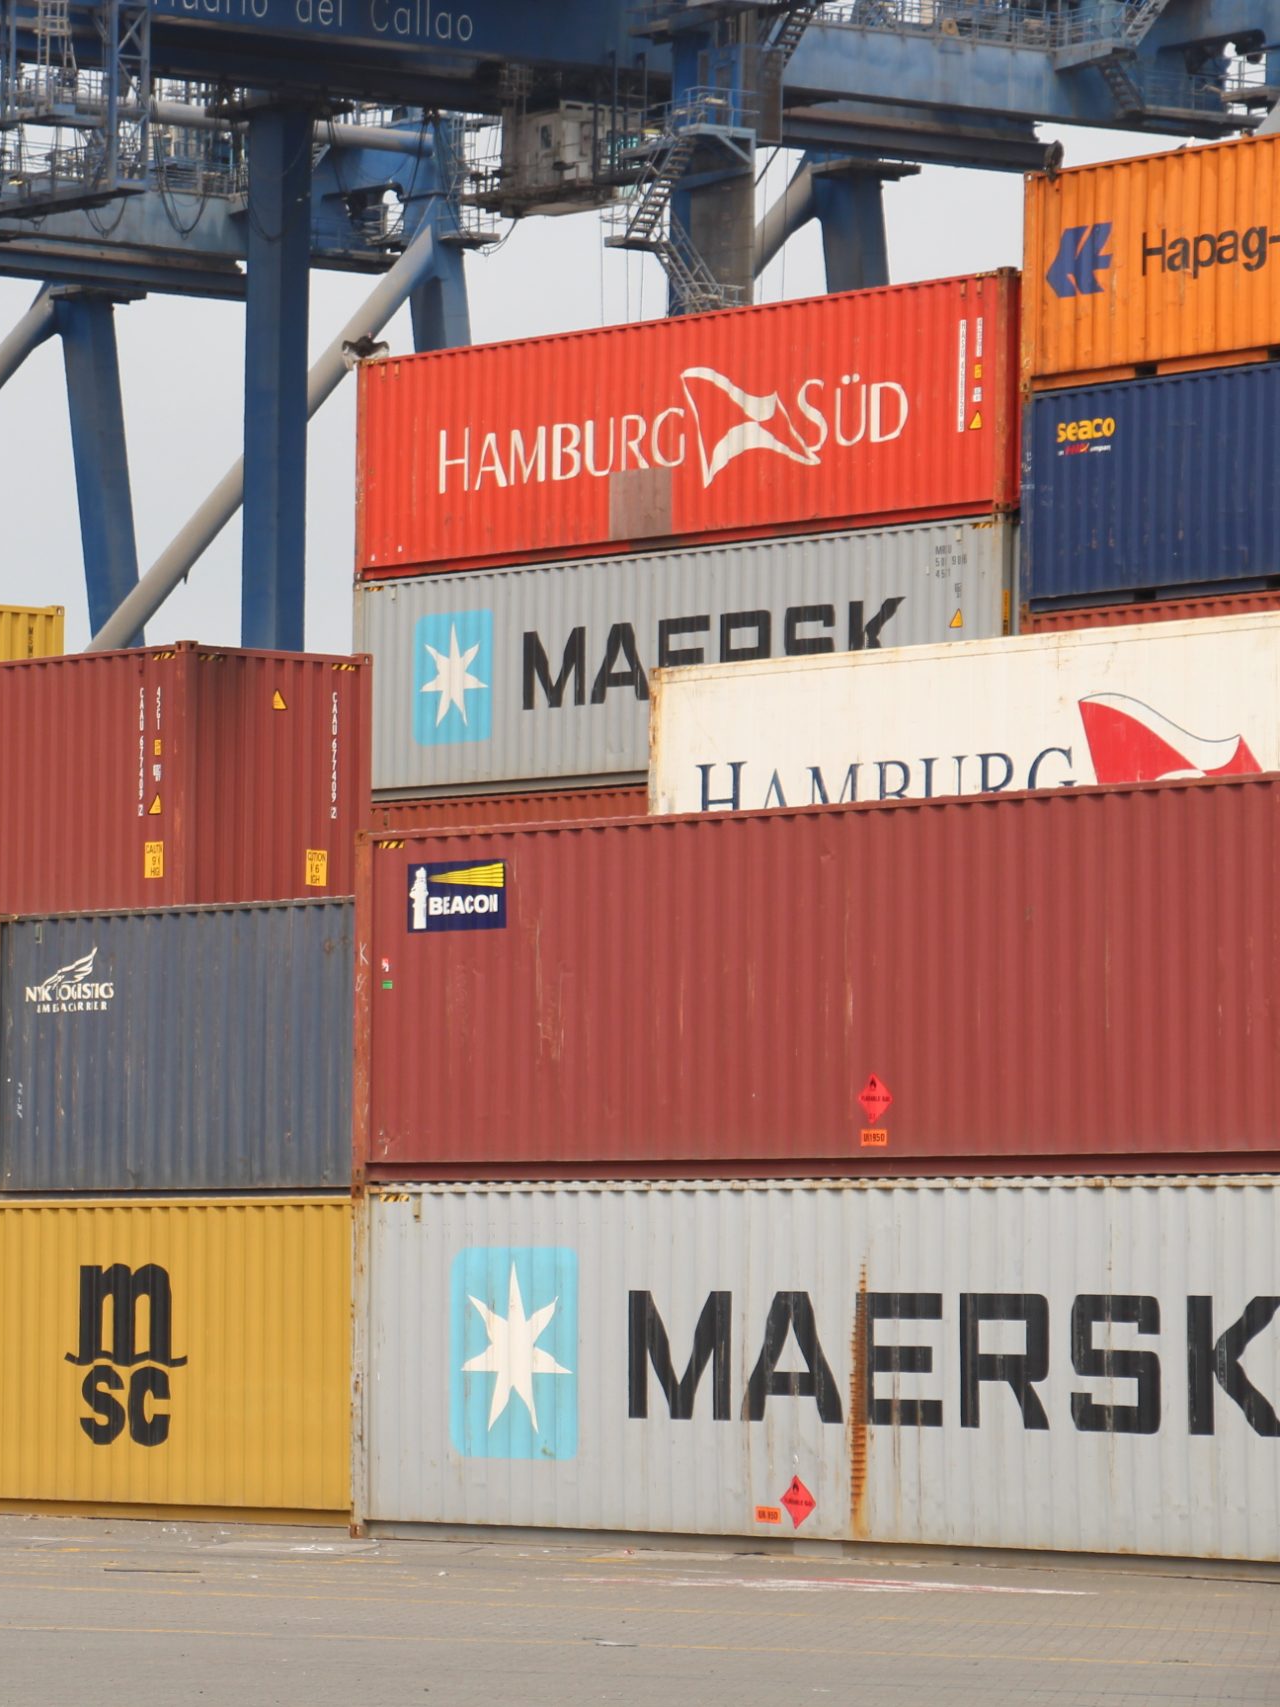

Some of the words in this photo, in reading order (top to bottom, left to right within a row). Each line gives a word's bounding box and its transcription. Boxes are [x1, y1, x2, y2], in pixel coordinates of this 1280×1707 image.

[371, 0, 473, 42] Callao
[438, 407, 685, 494] HAMBURG
[795, 373, 909, 453] SÜD
[1056, 417, 1116, 443] seaco
[428, 894, 498, 916] BEACON
[629, 1290, 1280, 1437] MAERSK
